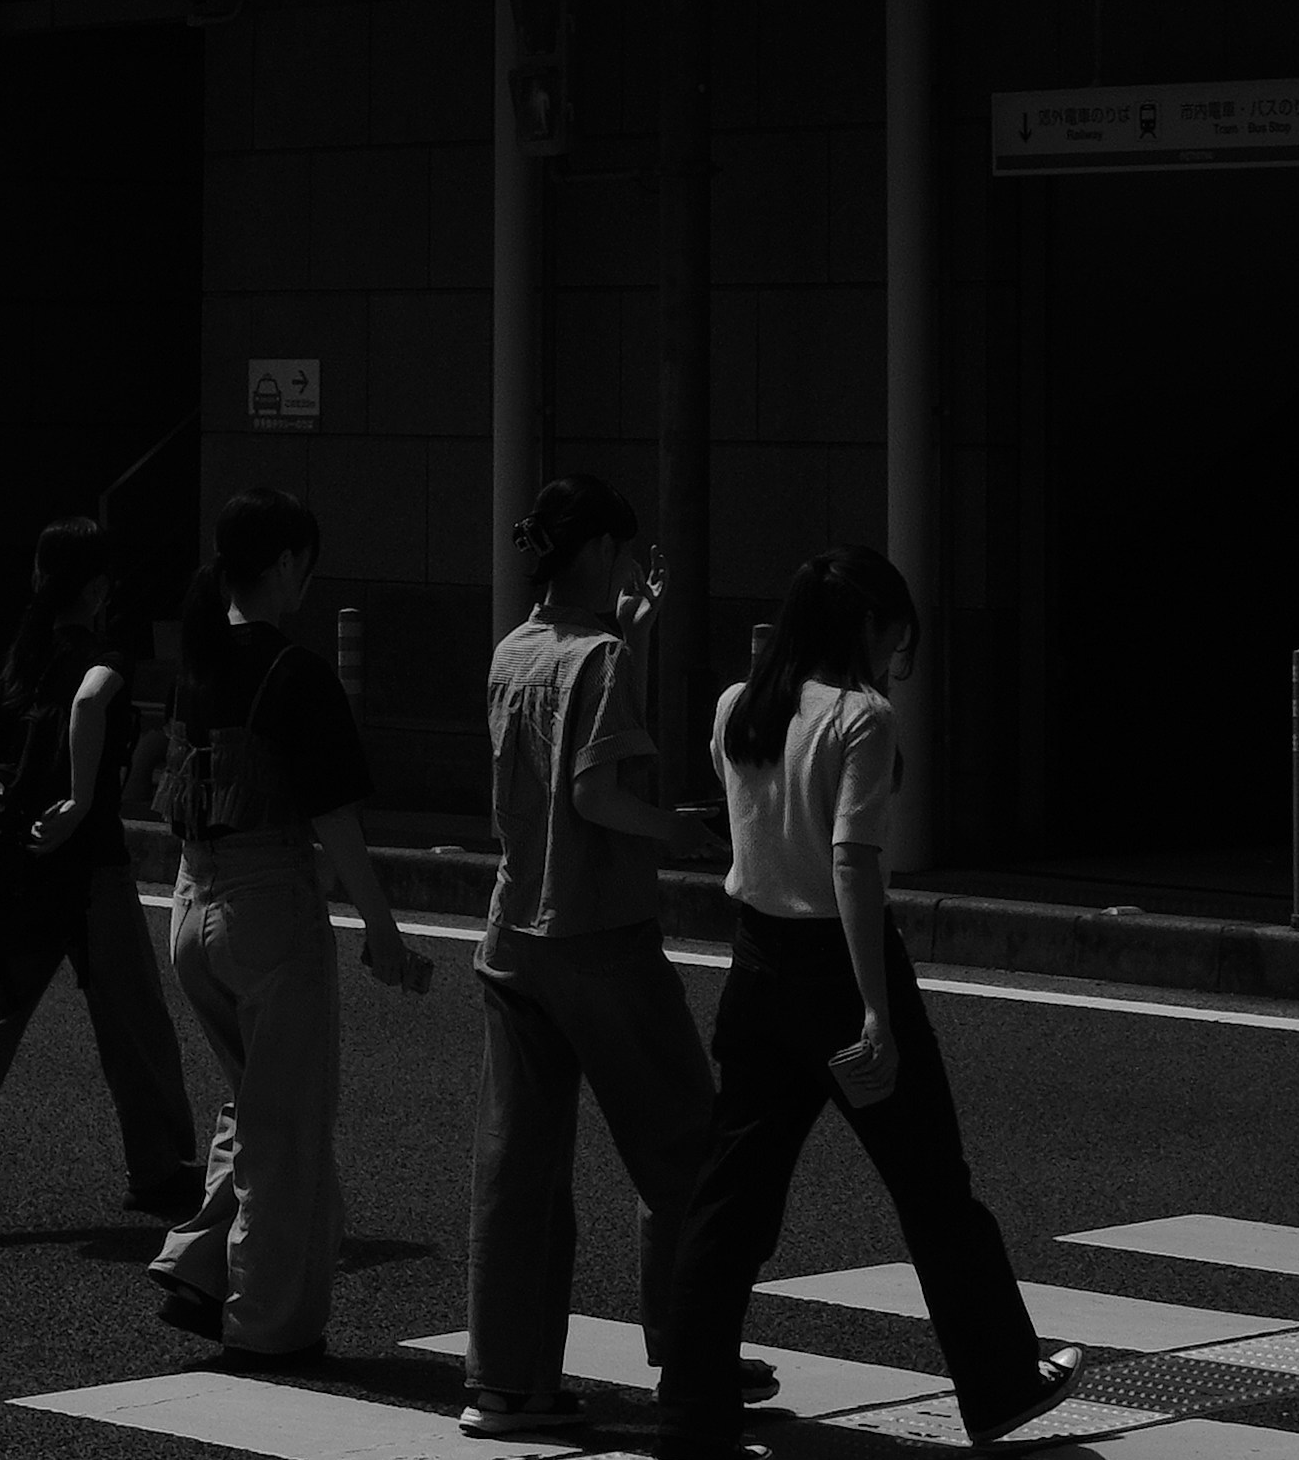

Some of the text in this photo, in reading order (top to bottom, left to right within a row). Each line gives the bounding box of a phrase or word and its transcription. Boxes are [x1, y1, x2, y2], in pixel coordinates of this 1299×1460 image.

[1212, 120, 1292, 135] Tram Bus Stop
[1065, 128, 1104, 142] Railway
